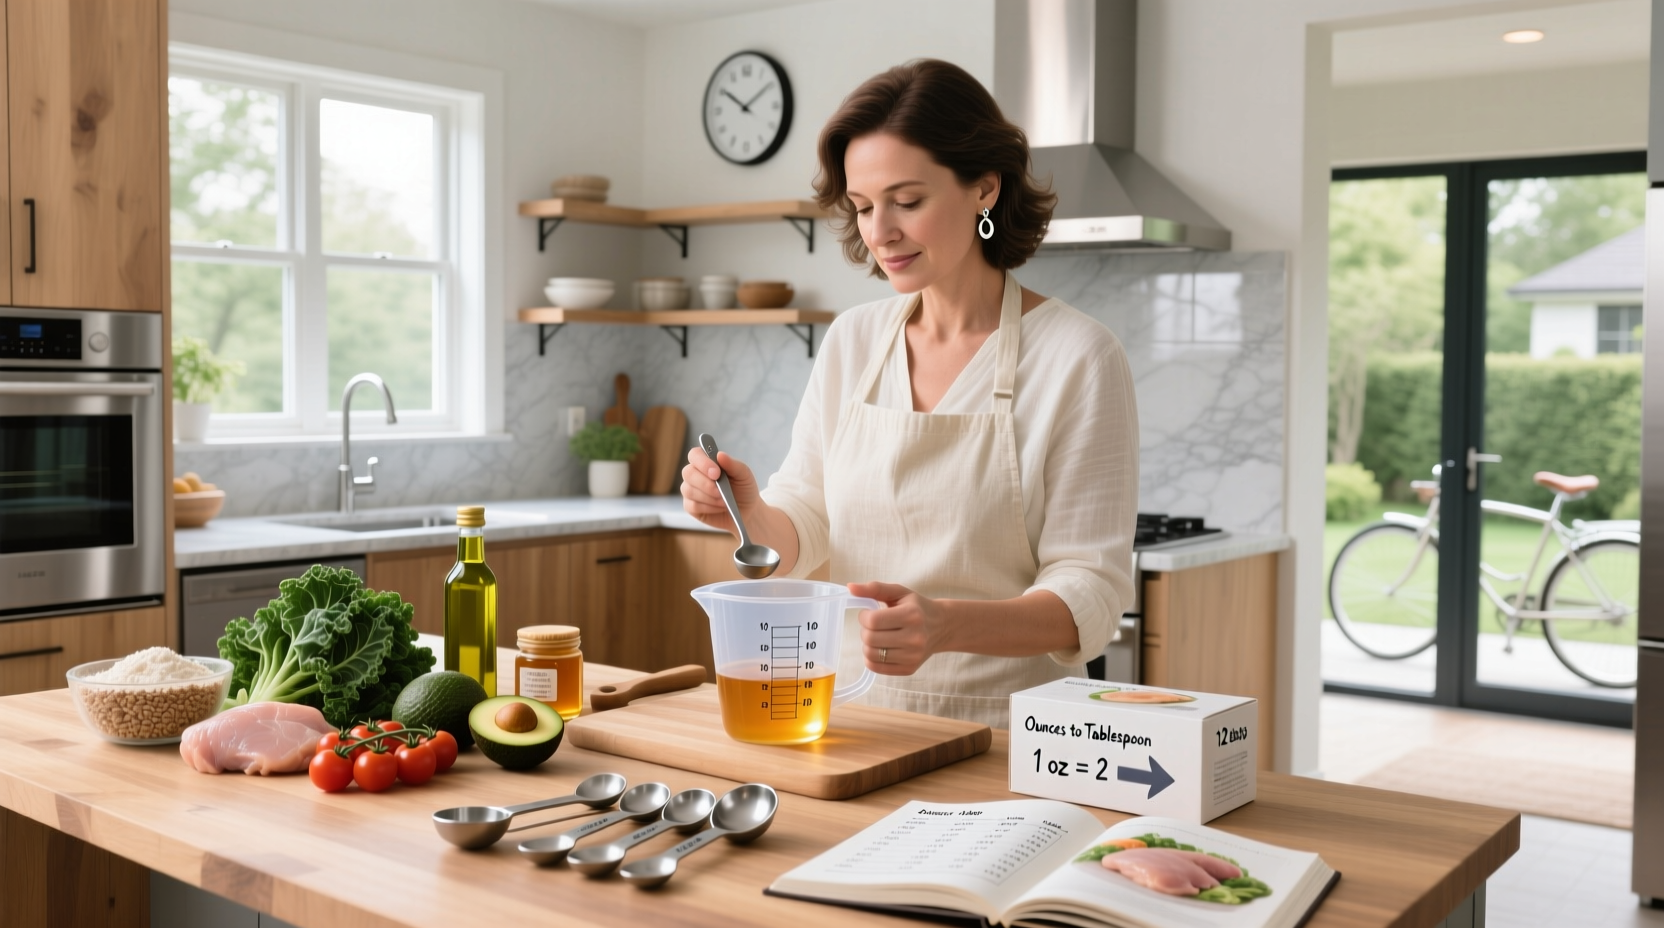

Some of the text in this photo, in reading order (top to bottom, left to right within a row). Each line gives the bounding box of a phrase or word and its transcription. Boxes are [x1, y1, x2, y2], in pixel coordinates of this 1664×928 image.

[760, 622, 769, 632] 10
[806, 641, 817, 650] 10
[760, 663, 769, 672] 10
[805, 661, 815, 670] 10
[1025, 715, 1152, 750] Ounces to Tablespoon
[1216, 727, 1228, 747] 12
[1033, 748, 1108, 781] 1 oz = 2
